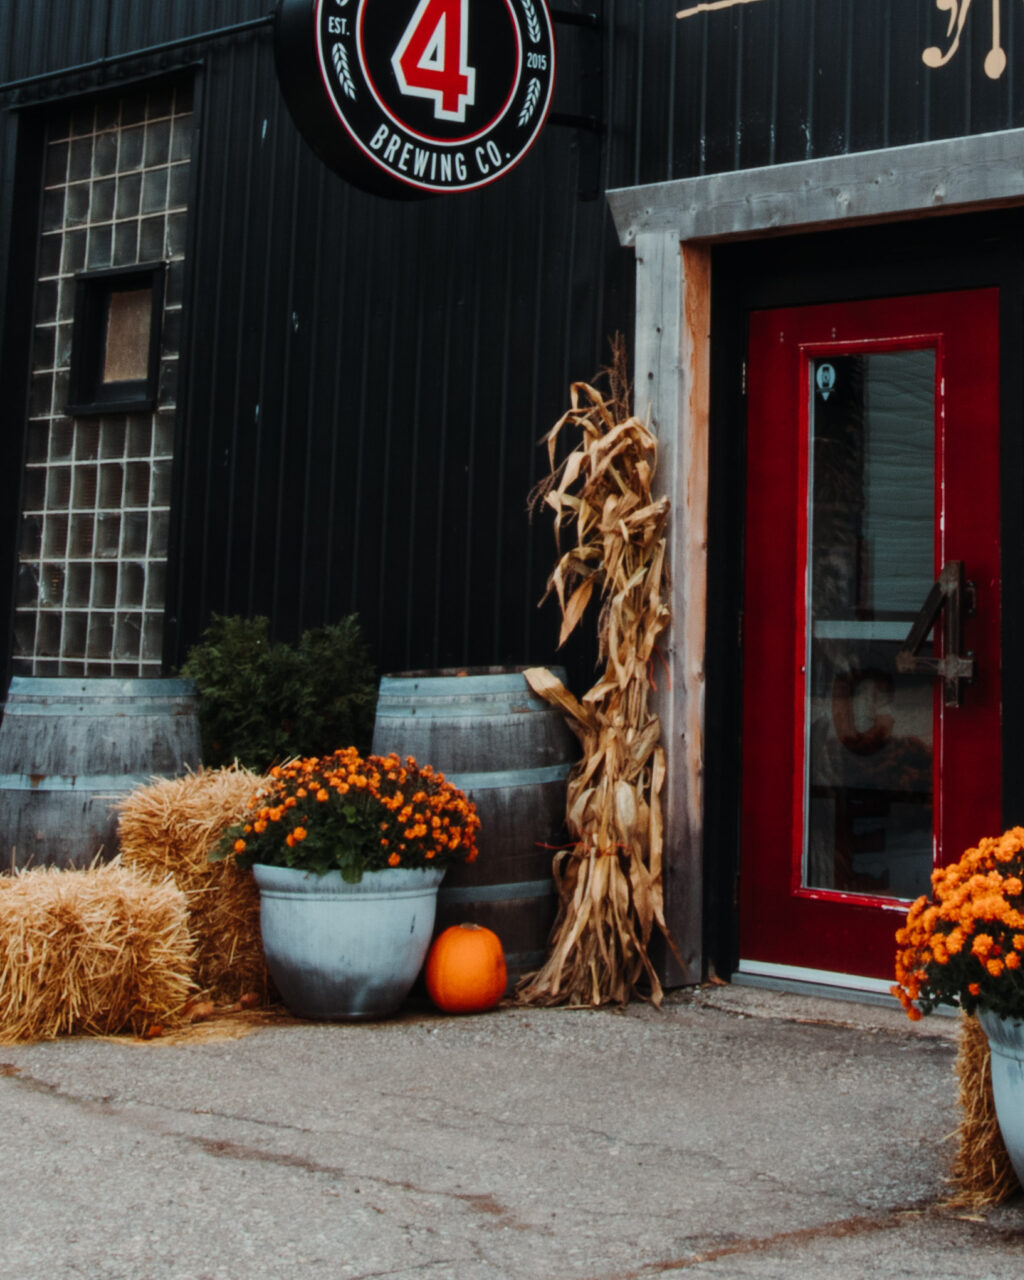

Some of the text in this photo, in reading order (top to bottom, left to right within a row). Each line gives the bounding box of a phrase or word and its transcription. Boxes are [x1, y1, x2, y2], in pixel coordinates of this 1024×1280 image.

[328, 16, 350, 36] EST.
[526, 52, 547, 71] 2015
[369, 123, 511, 182] BREWING CO.
